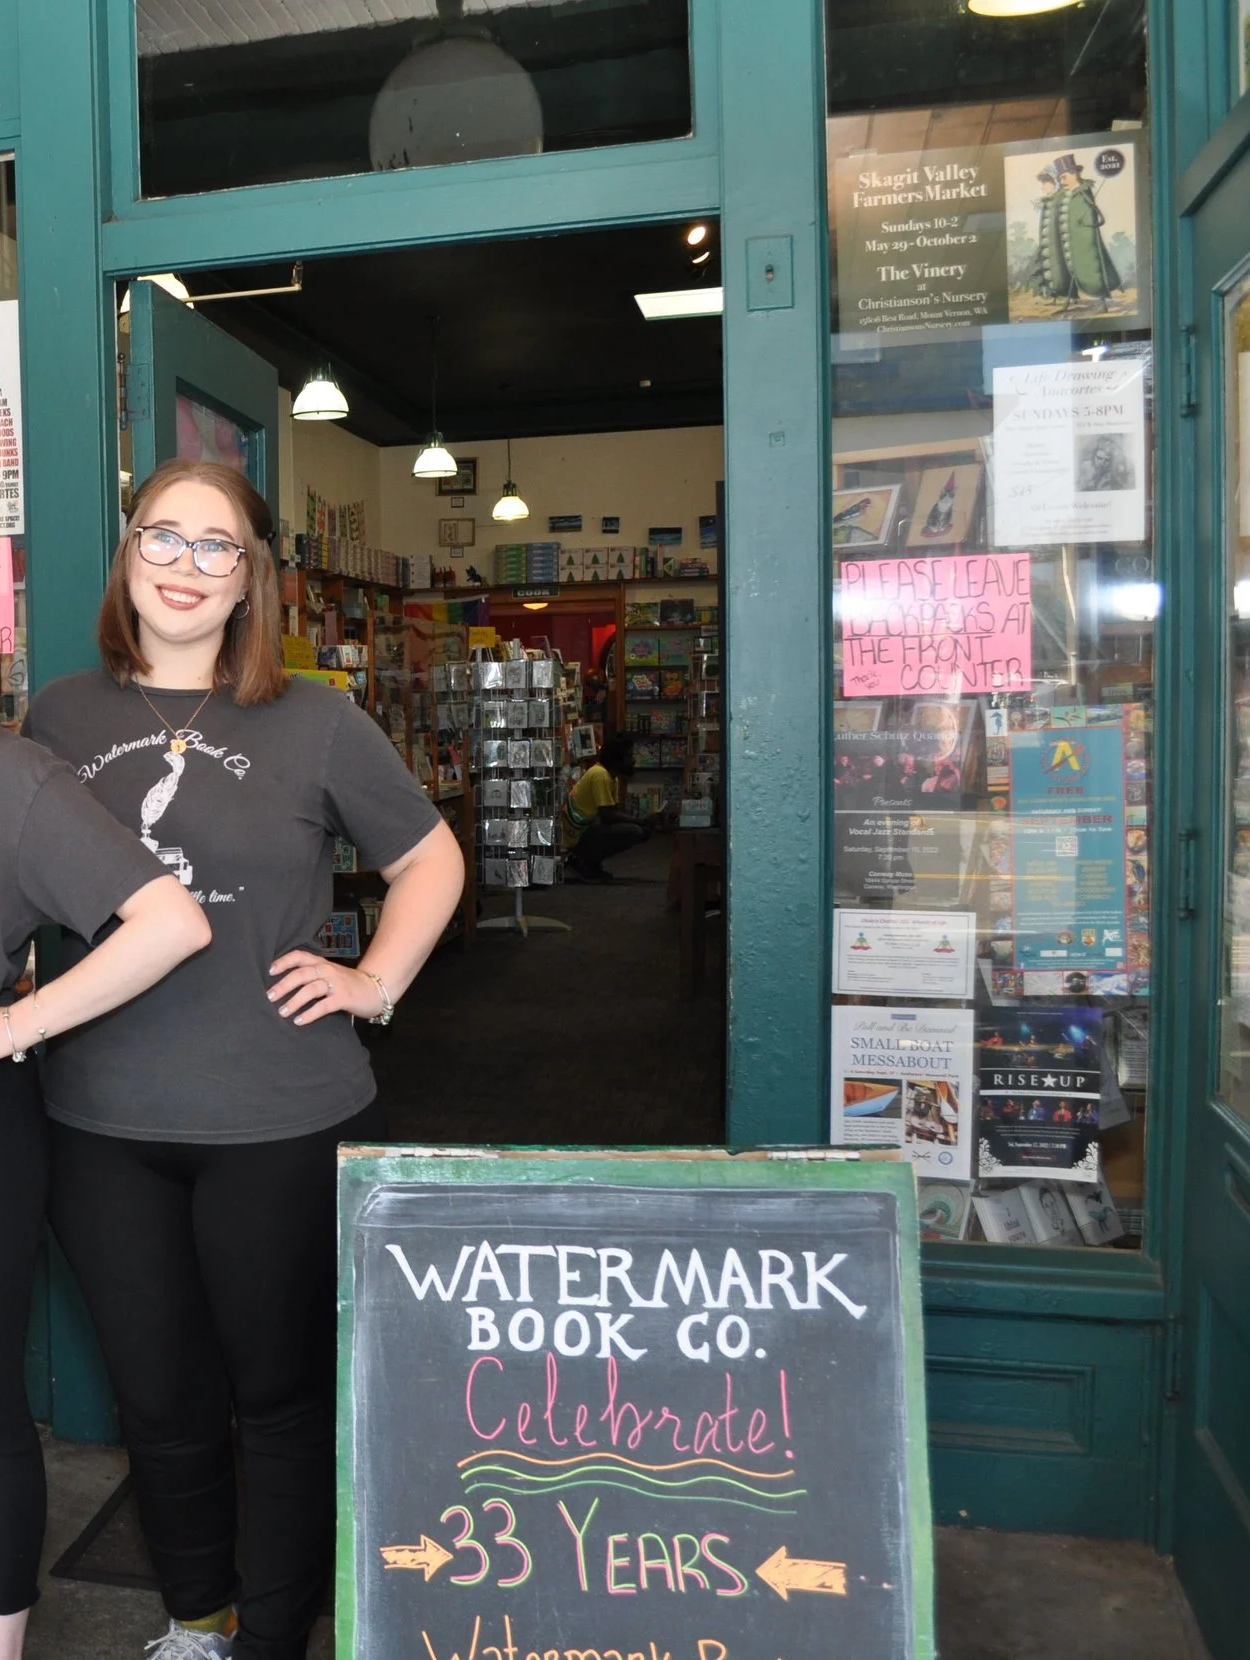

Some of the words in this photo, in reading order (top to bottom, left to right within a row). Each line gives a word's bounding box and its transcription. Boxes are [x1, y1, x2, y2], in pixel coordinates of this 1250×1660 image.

[859, 168, 919, 191] Skagit
[923, 163, 979, 184] Valley
[853, 191, 924, 208] Farmers
[925, 182, 988, 201] Market
[881, 220, 931, 233] Sundays
[933, 216, 959, 229] 10-2
[865, 240, 889, 254] May
[891, 240, 908, 252] 29
[916, 234, 967, 248] October
[968, 235, 978, 243] 2
[877, 265, 910, 282] The
[911, 262, 967, 280] Vinery
[917, 283, 927, 292] at
[858, 292, 940, 311] Christianson's
[942, 291, 988, 304] Nursery
[974, 306, 988, 315] WA
[1054, 368, 1116, 382] Drawing
[1041, 384, 1103, 398] Anacortes
[1013, 406, 1081, 421] SUNDAYS
[1084, 404, 1124, 417] 5-8PM
[2, 458, 19, 467] BAND
[2, 469, 19, 480] 9PM
[846, 559, 949, 602] PLEASE
[953, 557, 1030, 599] LEAVE
[850, 601, 996, 637] BACKPACKS
[1001, 601, 1030, 635] AT
[844, 636, 894, 666] THE
[901, 635, 993, 665] FRONT
[900, 657, 1024, 690] COUNTER
[77, 729, 167, 784] Watermark
[170, 728, 228, 759] Book
[871, 796, 913, 807] Presents
[848, 828, 871, 836] Vocal
[872, 828, 891, 836] Jazz
[850, 1037, 905, 1051] SMALL
[910, 1040, 954, 1053] BOAT
[852, 1054, 952, 1070] MESSABOUT
[993, 1073, 1039, 1086] RISE
[1059, 1075, 1086, 1088] UP
[385, 1239, 868, 1320] WATERMARK
[465, 1307, 648, 1361] BOOK
[676, 1310, 767, 1363] CO.
[465, 1351, 796, 1459] Celebrate!
[440, 1498, 532, 1588] 33
[557, 1497, 750, 1597] YEARS
